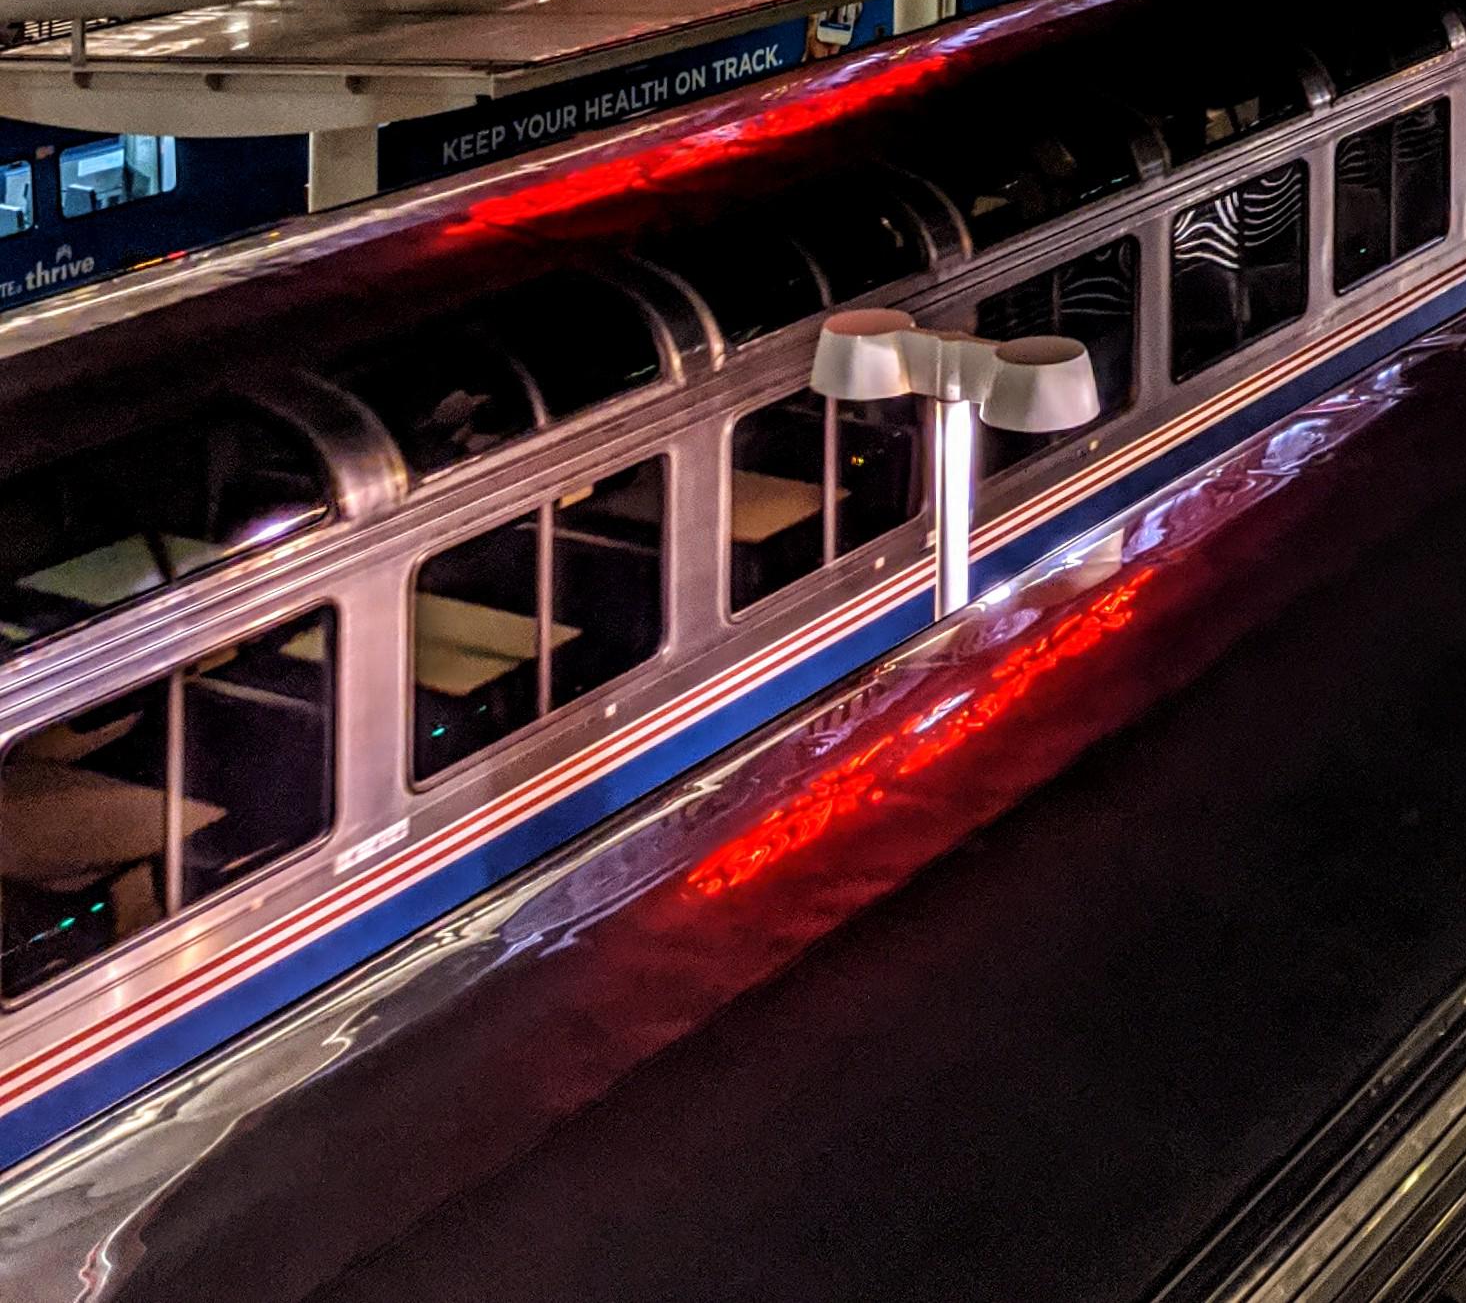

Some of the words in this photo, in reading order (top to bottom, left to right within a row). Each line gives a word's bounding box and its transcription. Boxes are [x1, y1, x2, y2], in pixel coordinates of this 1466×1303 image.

[442, 125, 506, 166] KEEP
[514, 103, 577, 142] YOUR
[585, 78, 668, 124] HEALTH
[675, 68, 707, 95] ON
[712, 44, 783, 85] TRACK.
[25, 256, 95, 291] thrive
